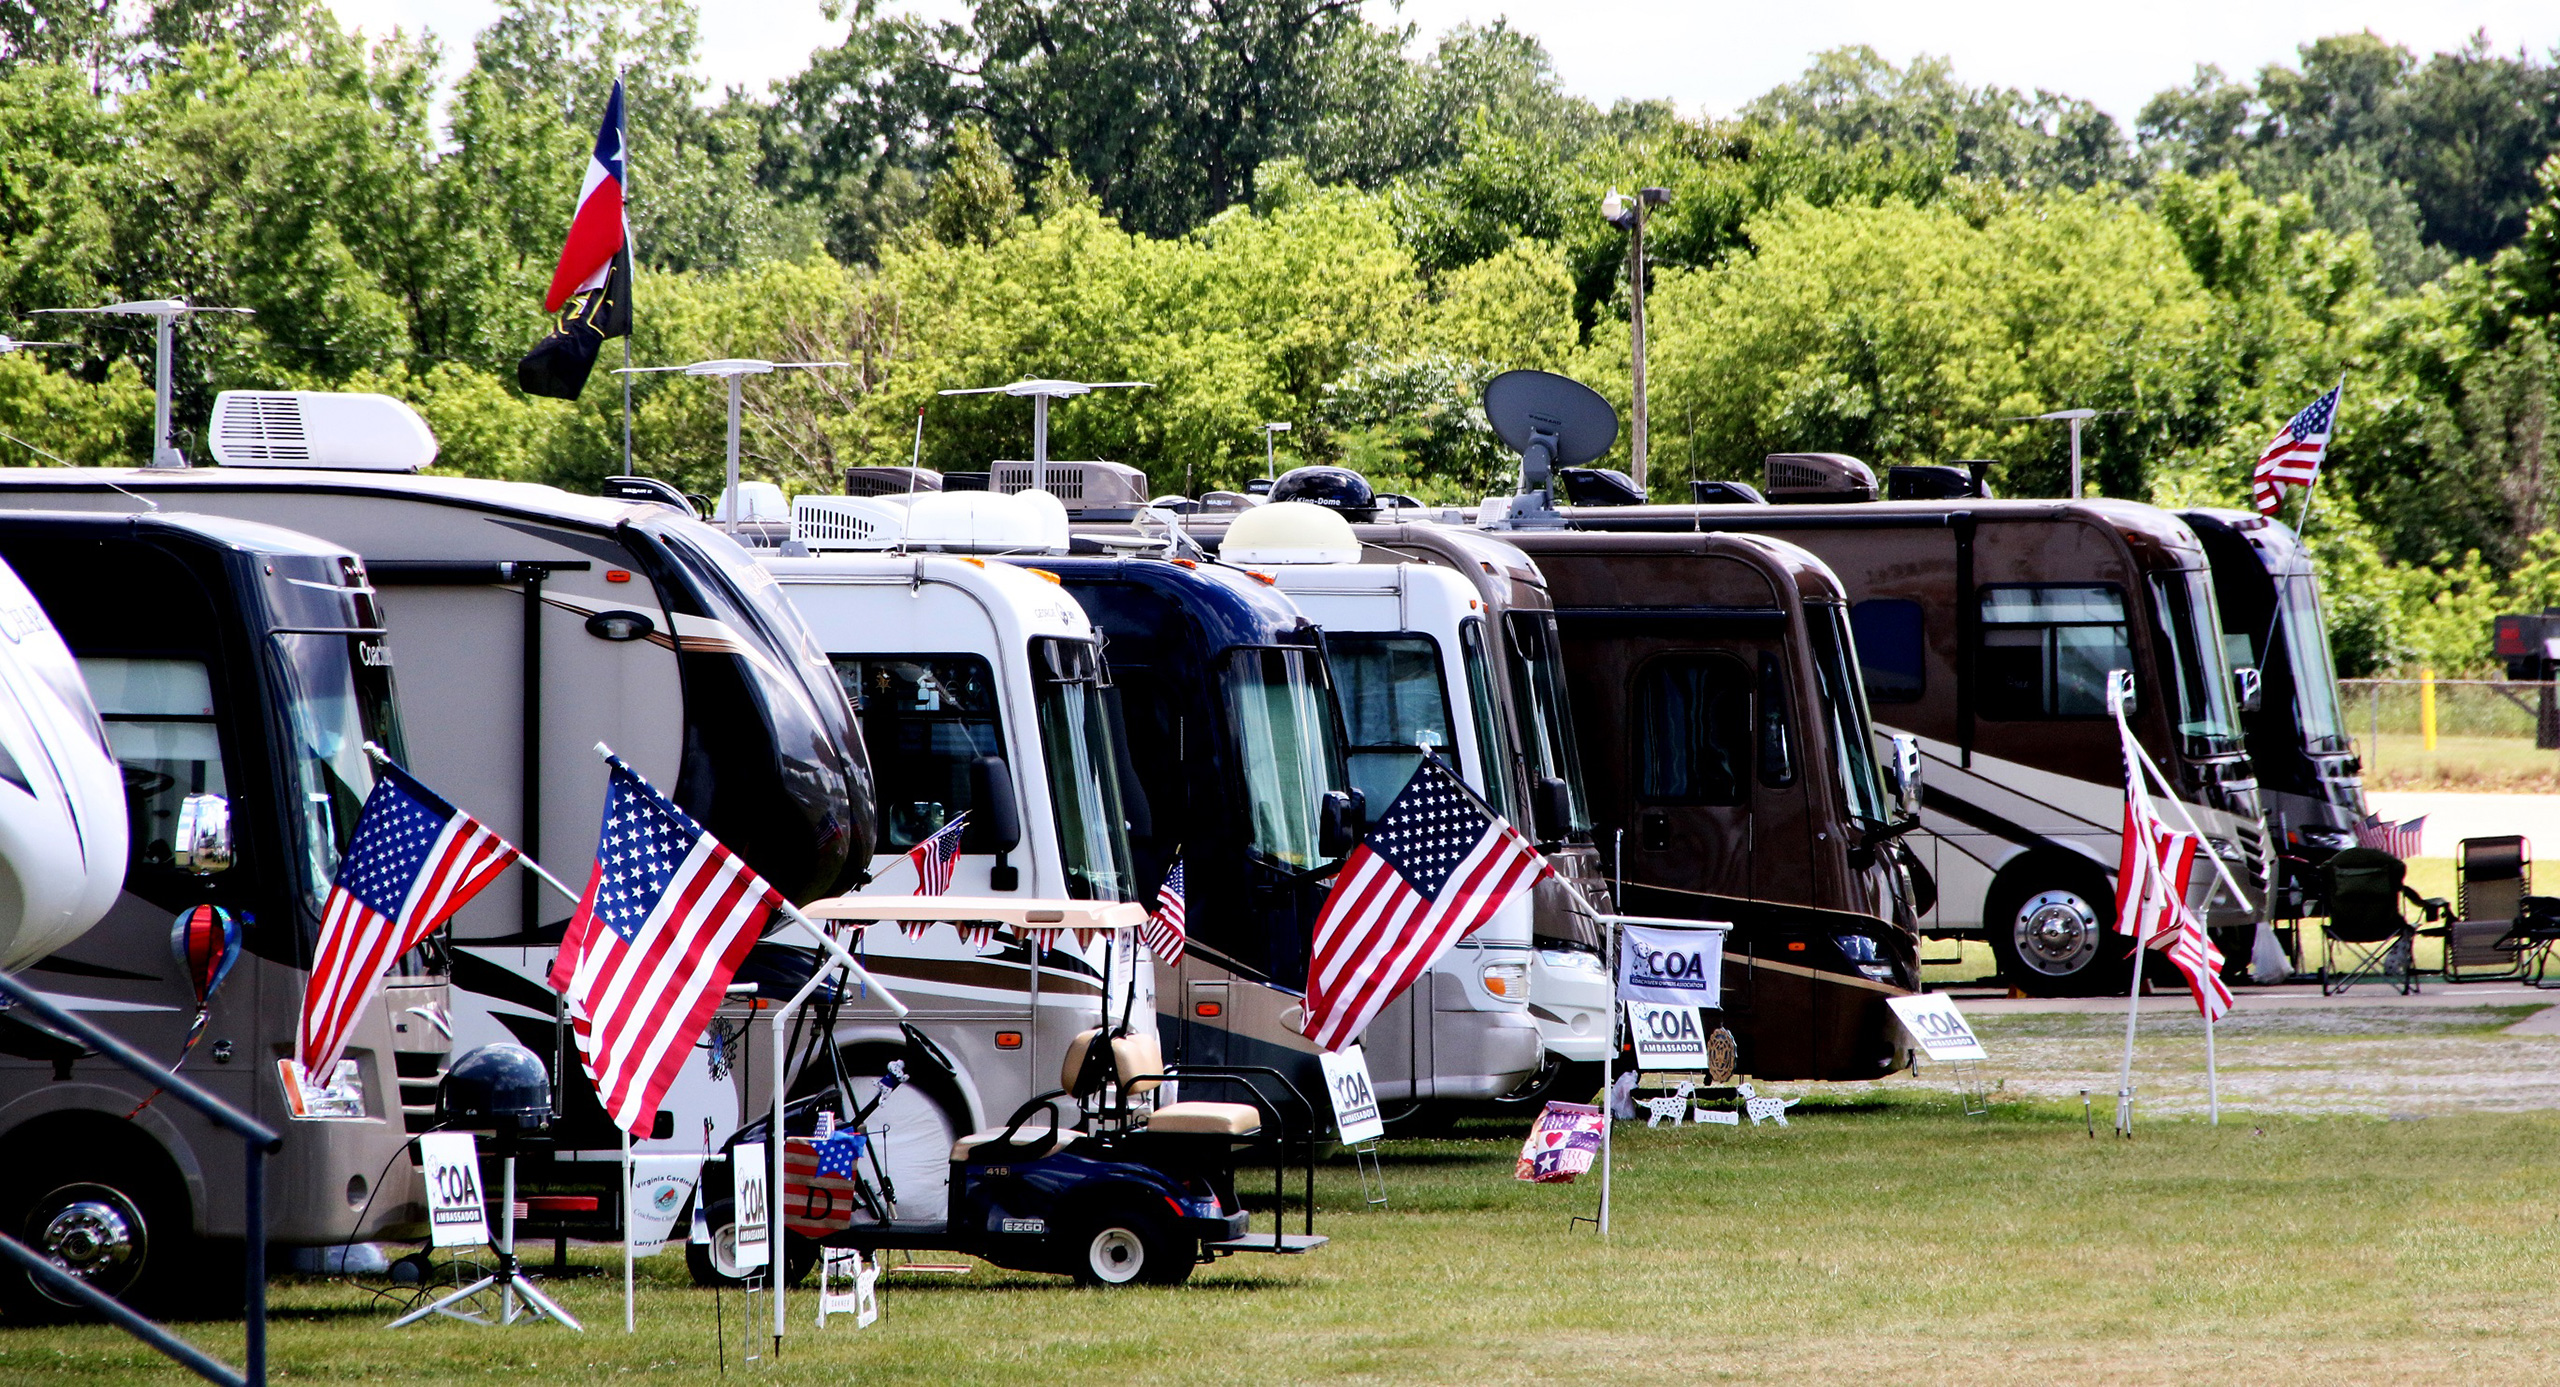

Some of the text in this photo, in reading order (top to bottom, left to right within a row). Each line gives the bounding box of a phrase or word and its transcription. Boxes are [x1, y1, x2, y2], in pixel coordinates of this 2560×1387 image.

[1648, 951, 1705, 980] COA
[1648, 1010, 1700, 1040] COA
[1917, 1011, 1968, 1036] COA
[1643, 1043, 1700, 1053] AMBASSADOR
[1926, 1037, 1973, 1048] AMBASSADOR
[1338, 1071, 1373, 1109] COA
[1341, 1108, 1376, 1125] AMBASSADOR
[986, 1167, 1008, 1176] 415
[439, 1165, 479, 1206] COA
[635, 1176, 665, 1189] Virginia
[744, 1178, 766, 1224] COA
[801, 1185, 833, 1221] D
[436, 1210, 480, 1223] AMBASSADOR
[634, 1239, 652, 1248] Larry
